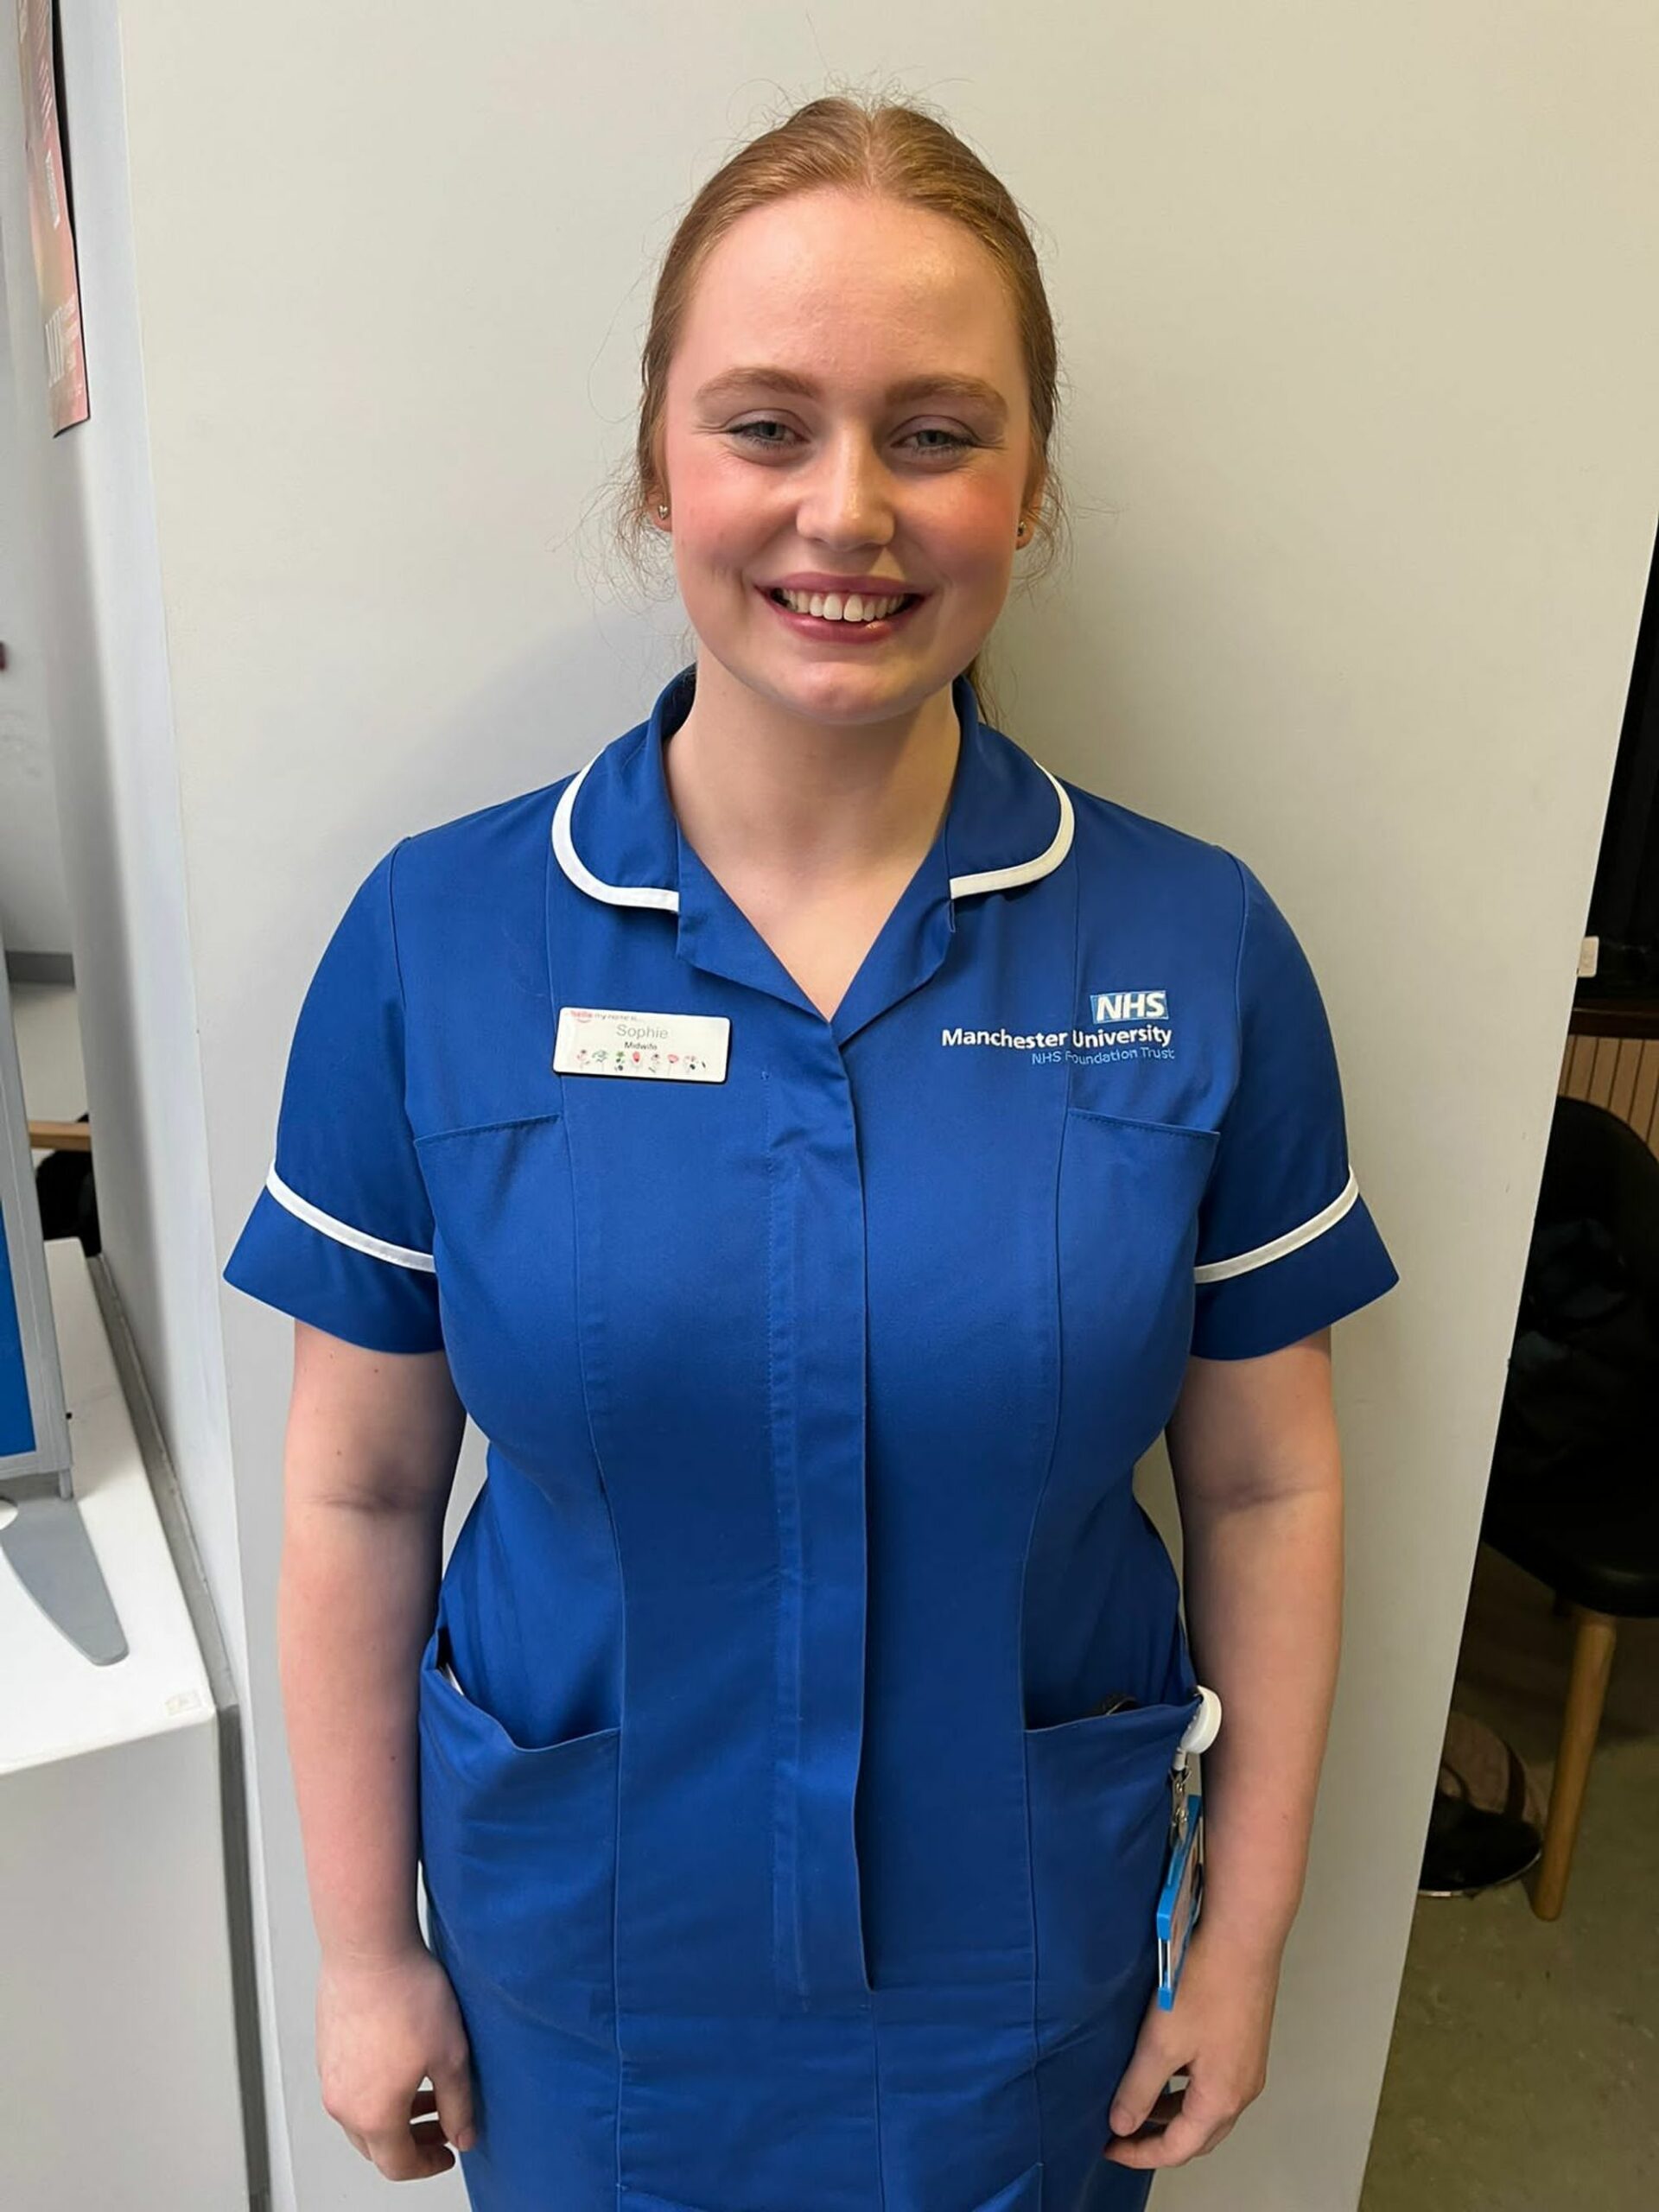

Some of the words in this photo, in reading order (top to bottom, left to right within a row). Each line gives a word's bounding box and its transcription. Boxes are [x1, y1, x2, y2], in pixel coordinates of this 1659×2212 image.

[1096, 993, 1166, 1021] NHS
[616, 1024, 669, 1040] Sophie
[941, 1028, 1068, 1049] Manchester
[1072, 1025, 1172, 1048] University
[624, 1041, 658, 1051] Midwife
[1032, 1051, 1062, 1065] NHS
[1065, 1049, 1138, 1065] Foundation
[1141, 1046, 1175, 1059] Trust
